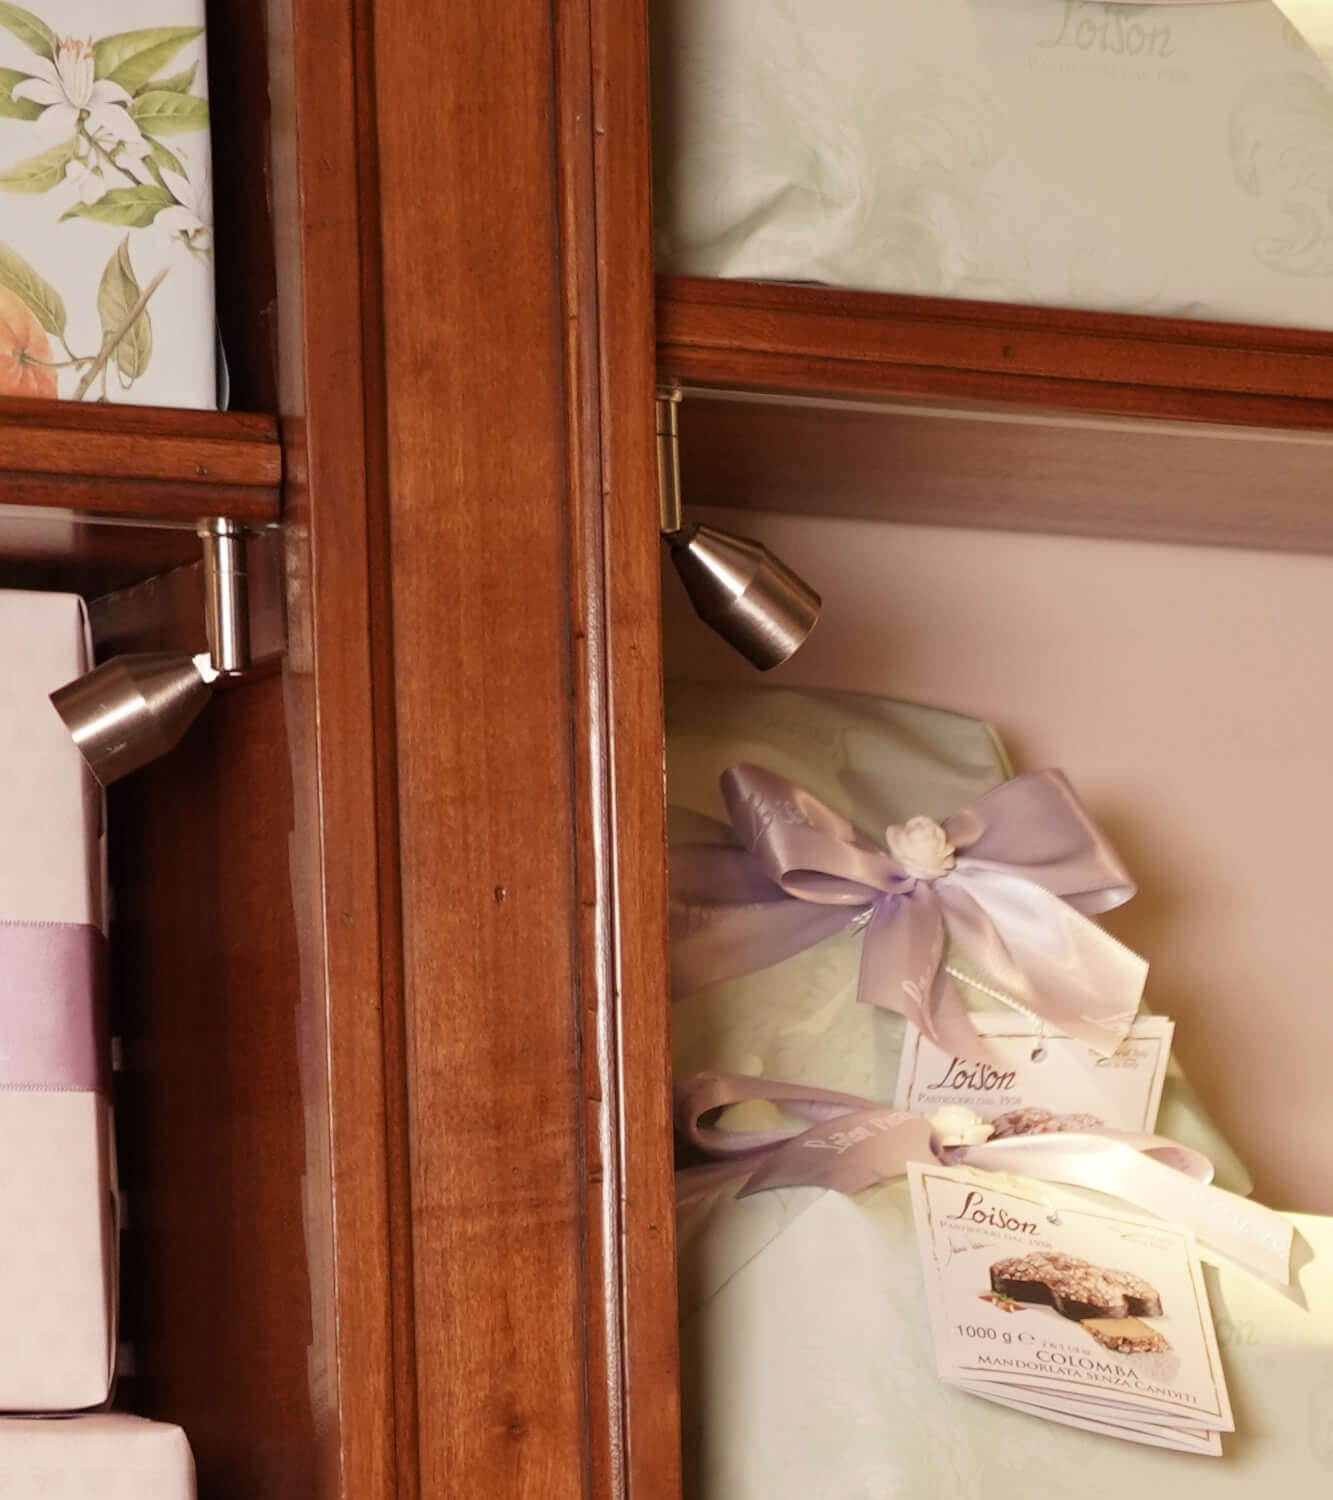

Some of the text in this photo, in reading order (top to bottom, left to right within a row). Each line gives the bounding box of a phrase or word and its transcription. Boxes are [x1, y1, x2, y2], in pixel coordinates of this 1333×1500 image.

[927, 1056, 1017, 1091] Loison
[946, 1191, 1040, 1236] Loison
[956, 1324, 1012, 1344] 1000 g
[1035, 1350, 1139, 1380] COLOMBA
[1086, 1371, 1130, 1389] SENZA
